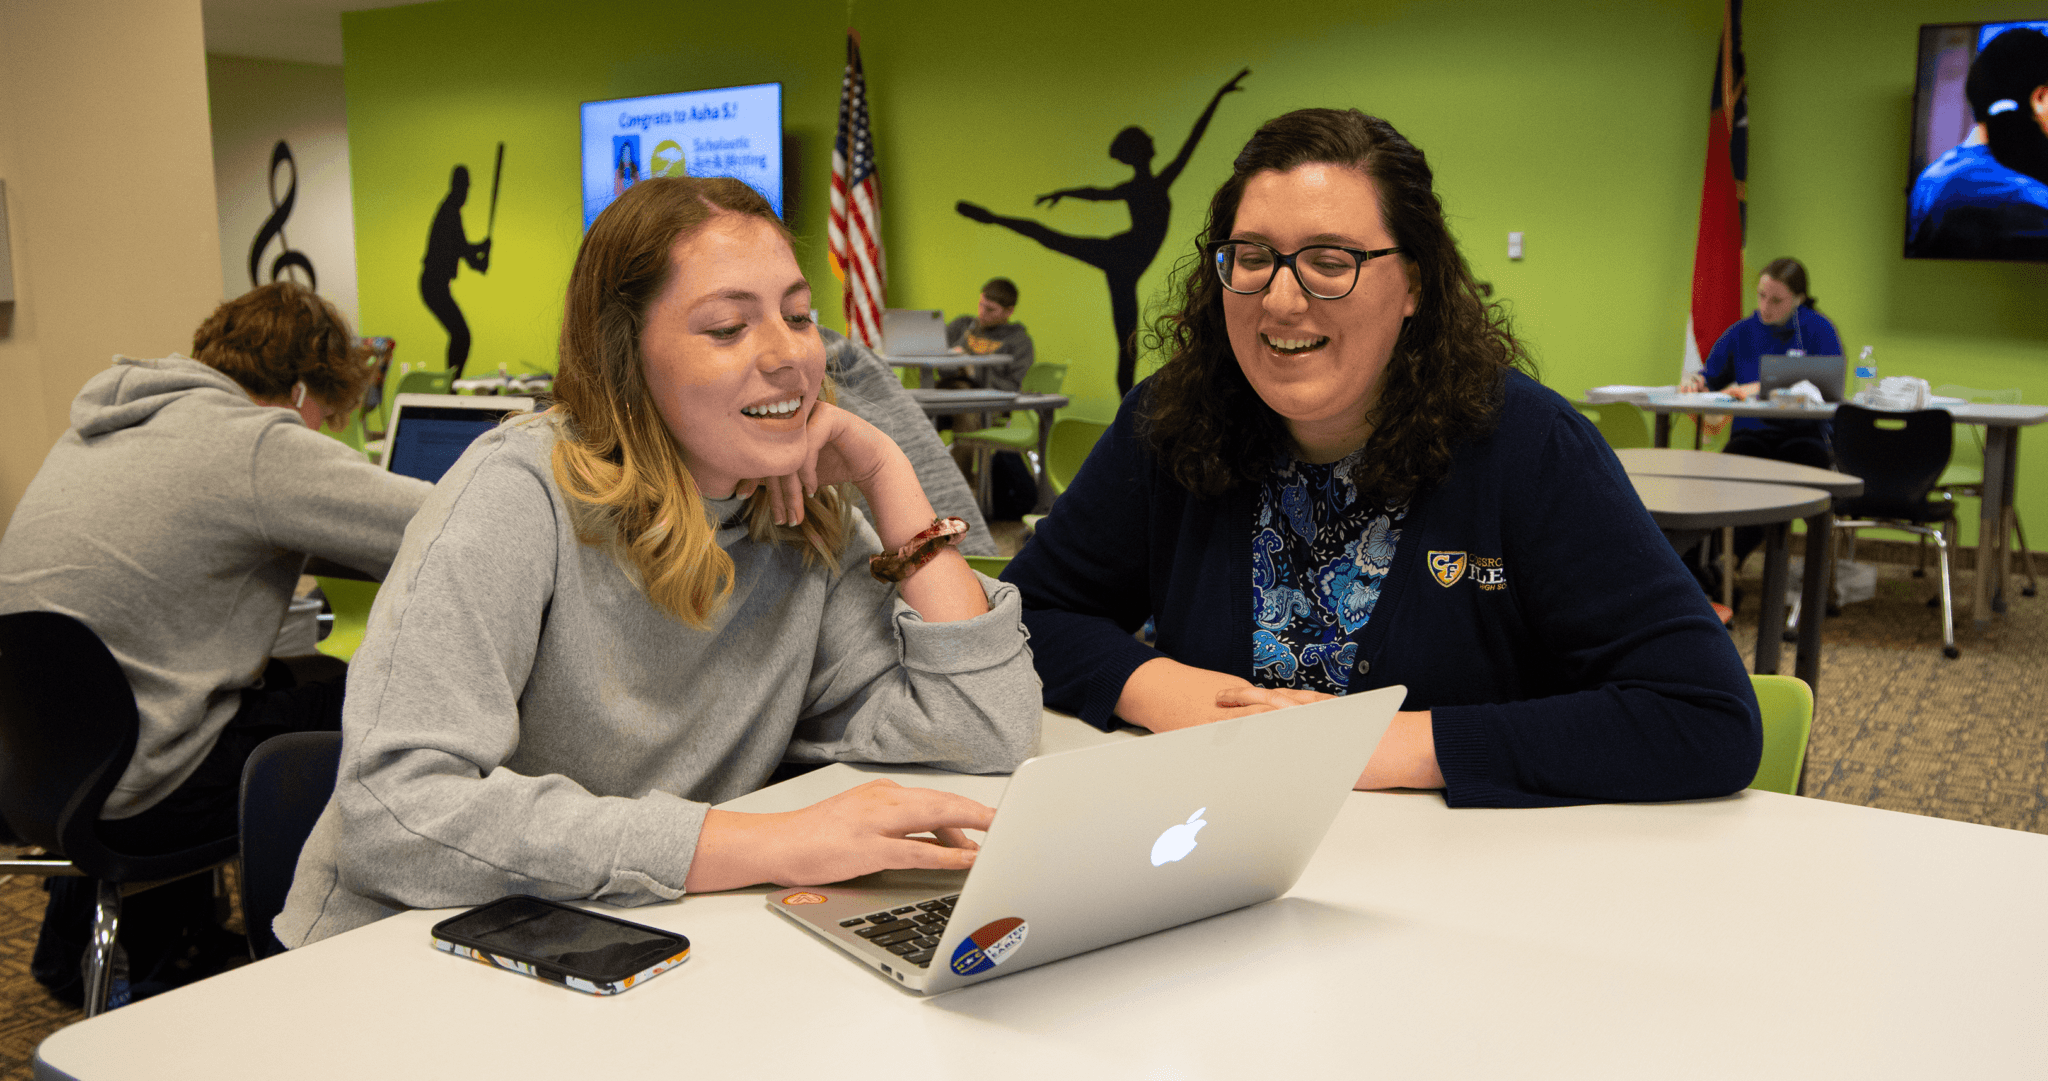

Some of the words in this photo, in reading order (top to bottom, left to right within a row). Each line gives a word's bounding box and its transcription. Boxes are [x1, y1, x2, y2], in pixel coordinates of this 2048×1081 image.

[618, 112, 671, 131] Congrats
[674, 110, 686, 123] to
[693, 138, 749, 151] Scholastic
[726, 155, 767, 169] Writing
[1467, 563, 1507, 584] FLE
[991, 935, 1022, 958] EARLY
